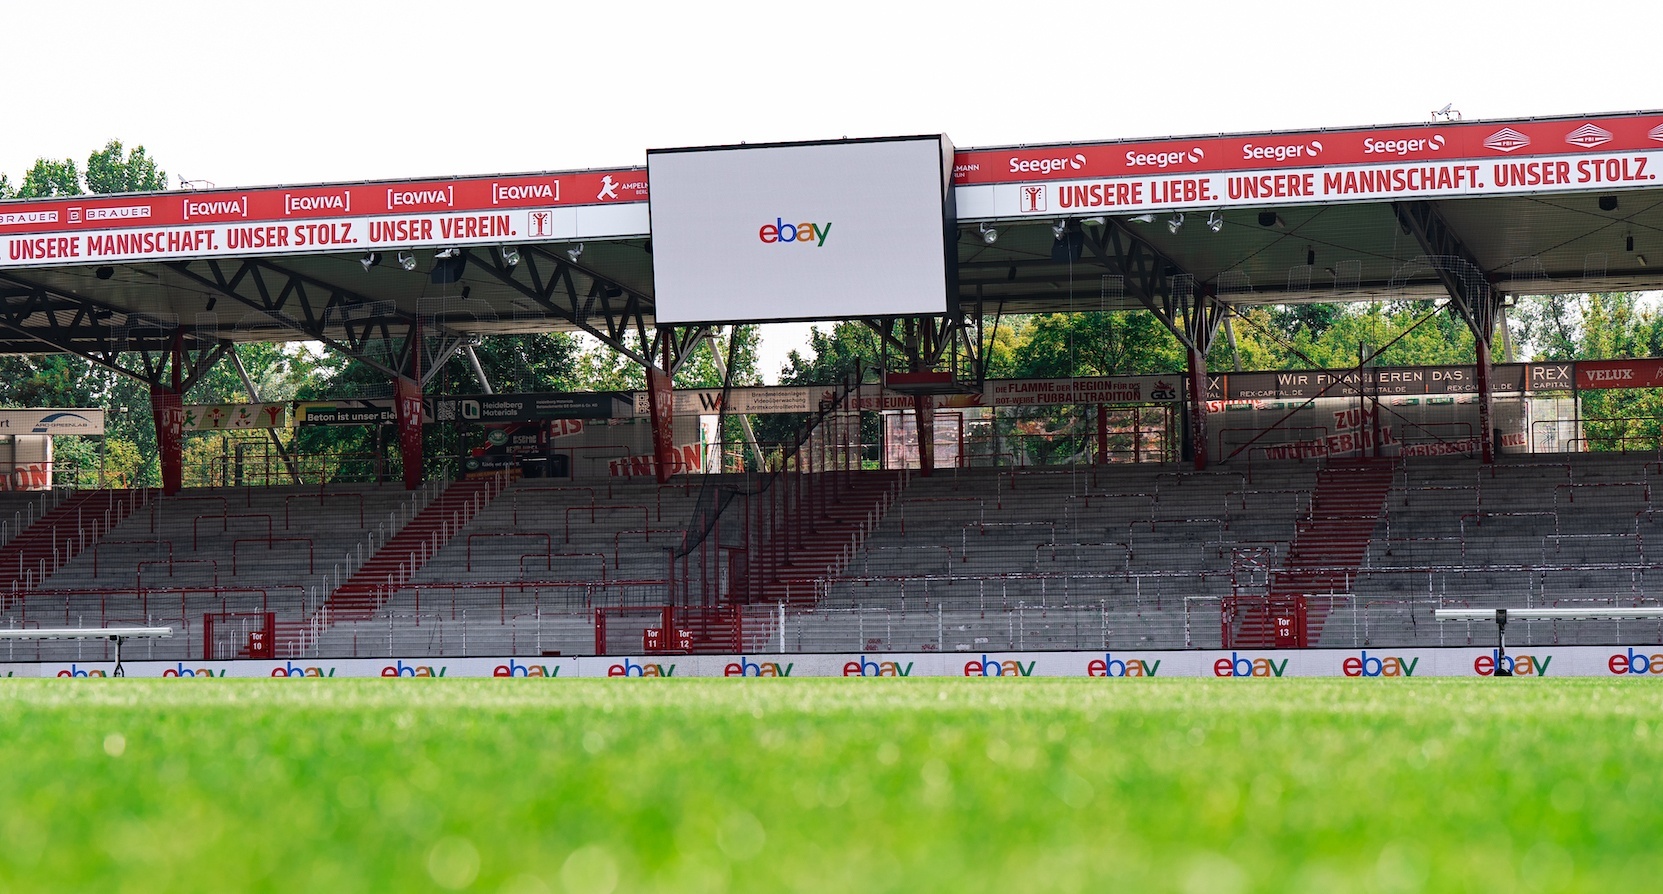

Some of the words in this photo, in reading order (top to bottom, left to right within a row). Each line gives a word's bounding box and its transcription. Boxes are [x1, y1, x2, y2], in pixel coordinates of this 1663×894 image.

[1364, 137, 1426, 155] Seeger
[1243, 144, 1304, 161] Seeger
[1125, 150, 1185, 168] Seeger
[1009, 157, 1068, 174] Seeger
[1059, 182, 1143, 208] UNSERE
[1151, 178, 1219, 204] LIEBE.
[1228, 173, 1314, 200] UNSERE
[1323, 165, 1485, 195] MANNSCHAFT.
[1494, 161, 1570, 187] UNSER
[1577, 157, 1656, 184] STOLZ.
[87, 207, 150, 219] BRAUER
[9, 236, 80, 260] UNSERE
[87, 229, 219, 257] MANNSCHAFT.
[227, 226, 289, 249] UNSER
[294, 222, 358, 246] STOLZ.
[369, 218, 432, 243] UNSER
[439, 215, 517, 239] VEREIN.
[759, 217, 832, 247] ebay
[1432, 370, 1470, 381] DAS.
[1586, 369, 1634, 381] VELUX
[1008, 382, 1054, 393] FLAMME
[1056, 384, 1071, 392] DER
[1072, 380, 1112, 391] REGION
[1150, 390, 1176, 400] GAS
[482, 401, 524, 410] Heidelberg
[307, 413, 335, 422] Beton
[337, 411, 350, 421] ist
[352, 412, 379, 421] unser
[381, 411, 398, 420] Ele
[482, 409, 518, 417] Materials
[1277, 617, 1290, 626] Tor
[251, 632, 263, 640] Tor
[647, 629, 658, 637] Tor
[678, 629, 690, 638] Tor
[1279, 627, 1290, 637] 13
[253, 642, 262, 650] 10
[648, 640, 657, 648] 11
[680, 640, 690, 648] 12
[964, 654, 1036, 677] ebay
[1087, 653, 1161, 677] ebay
[1213, 652, 1289, 677] ebay
[1342, 650, 1419, 677] ebay
